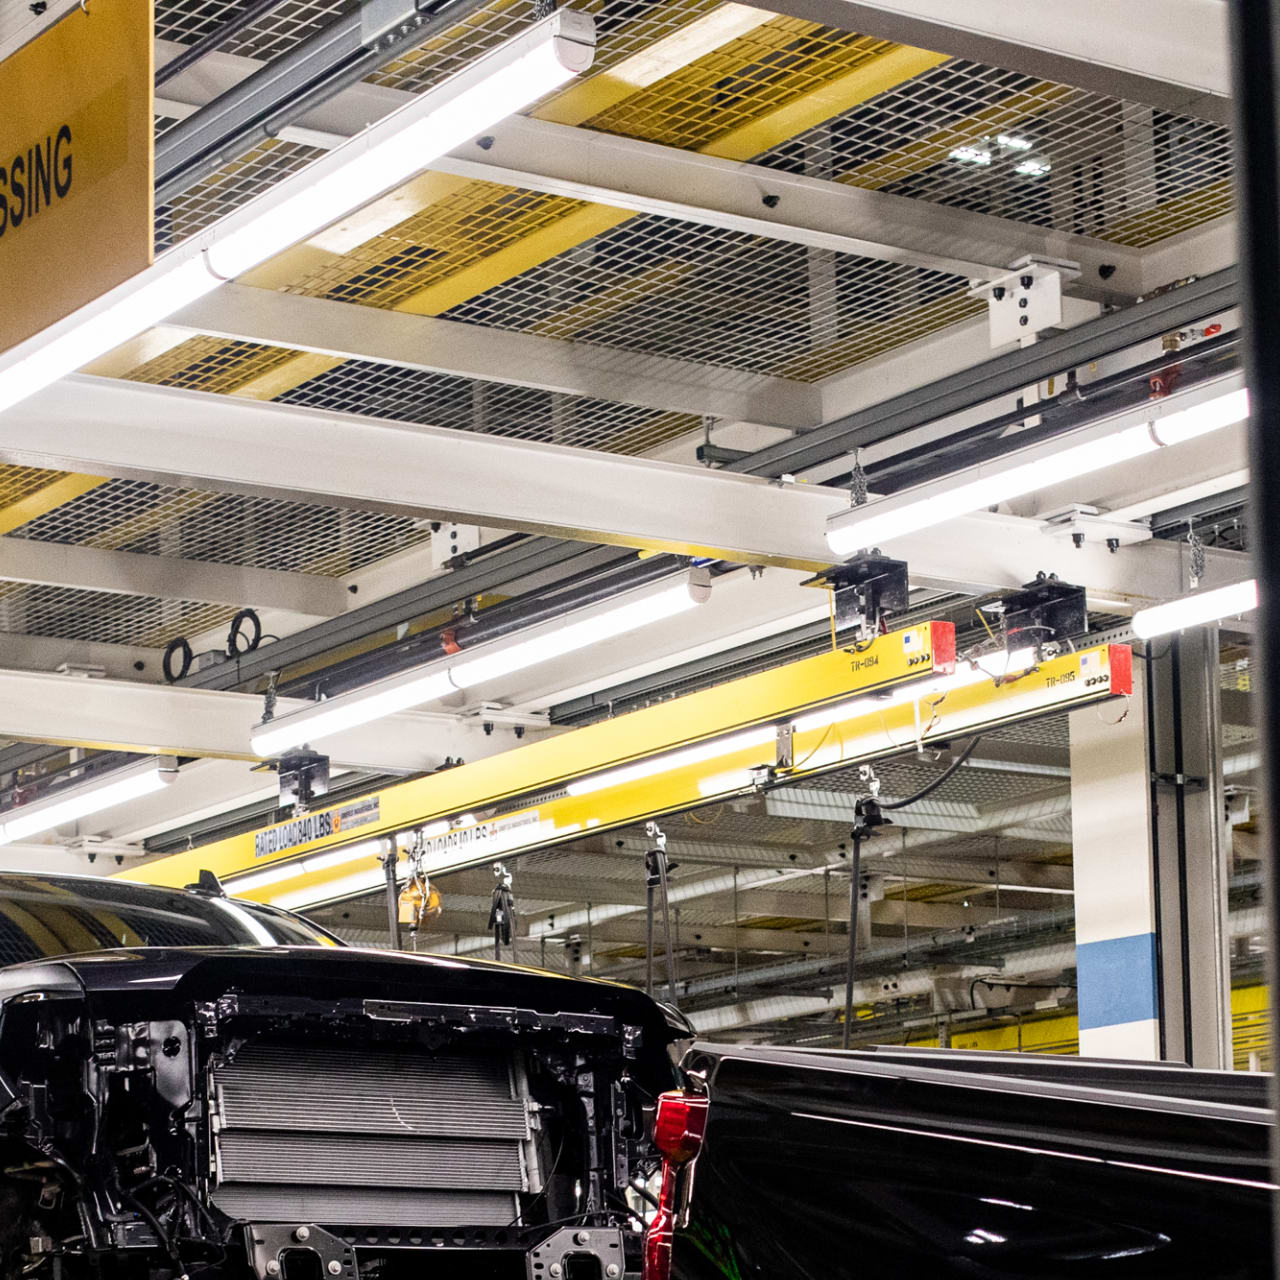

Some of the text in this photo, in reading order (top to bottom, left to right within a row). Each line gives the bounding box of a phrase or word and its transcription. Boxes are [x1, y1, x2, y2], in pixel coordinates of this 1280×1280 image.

[255, 826, 278, 858] RATED
[279, 820, 298, 851] LOAD
[297, 816, 314, 846] 840
